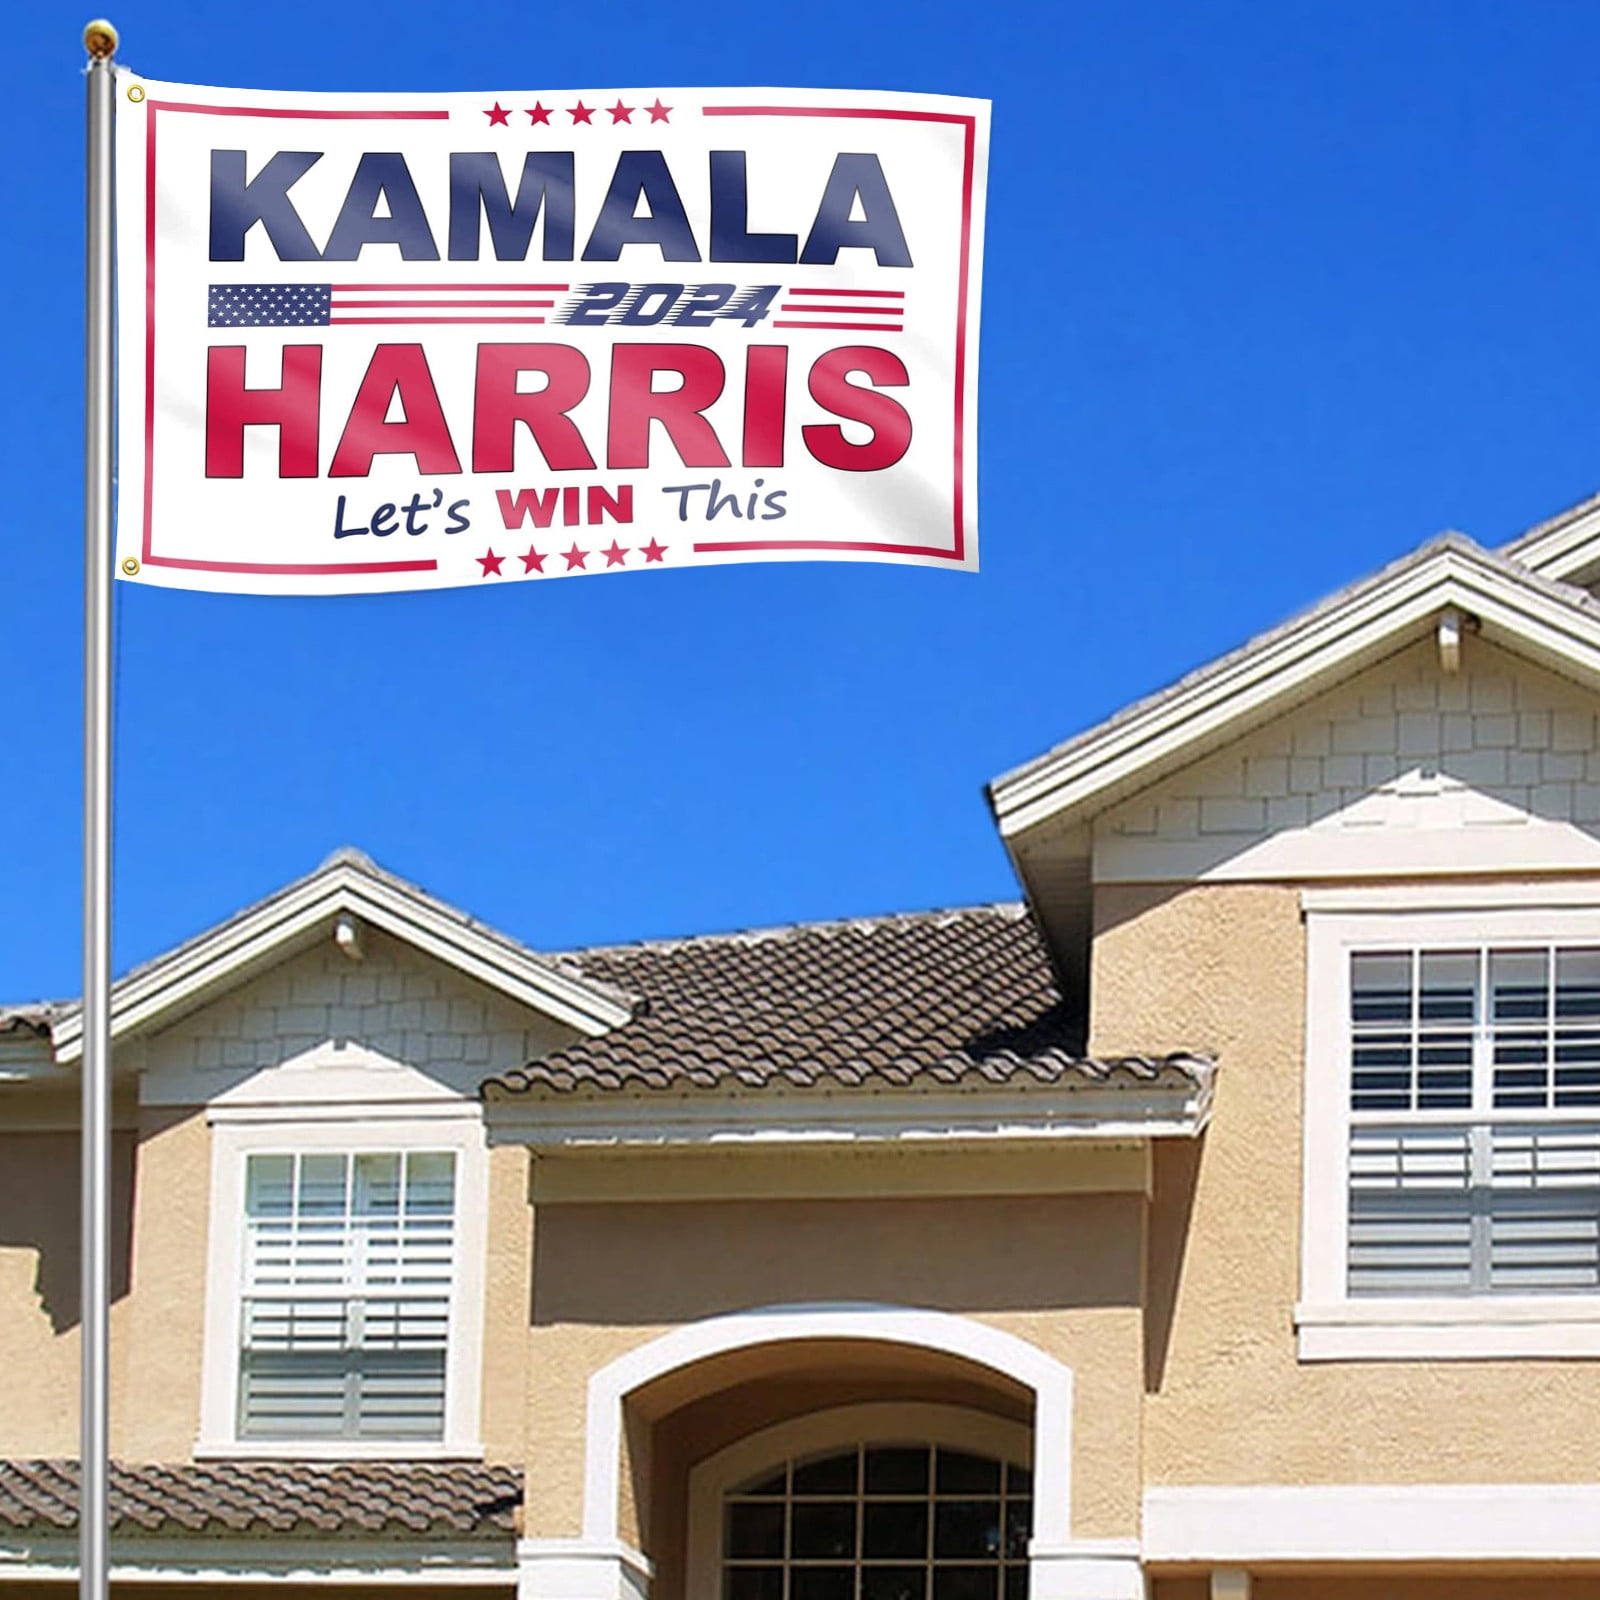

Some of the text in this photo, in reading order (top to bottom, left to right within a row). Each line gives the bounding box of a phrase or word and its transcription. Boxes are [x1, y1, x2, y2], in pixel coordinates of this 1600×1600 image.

[208, 149, 914, 269] KAMALA
[553, 281, 783, 329] 2024
[204, 343, 912, 480] HARRIS
[333, 478, 789, 540] Let's WIN This
